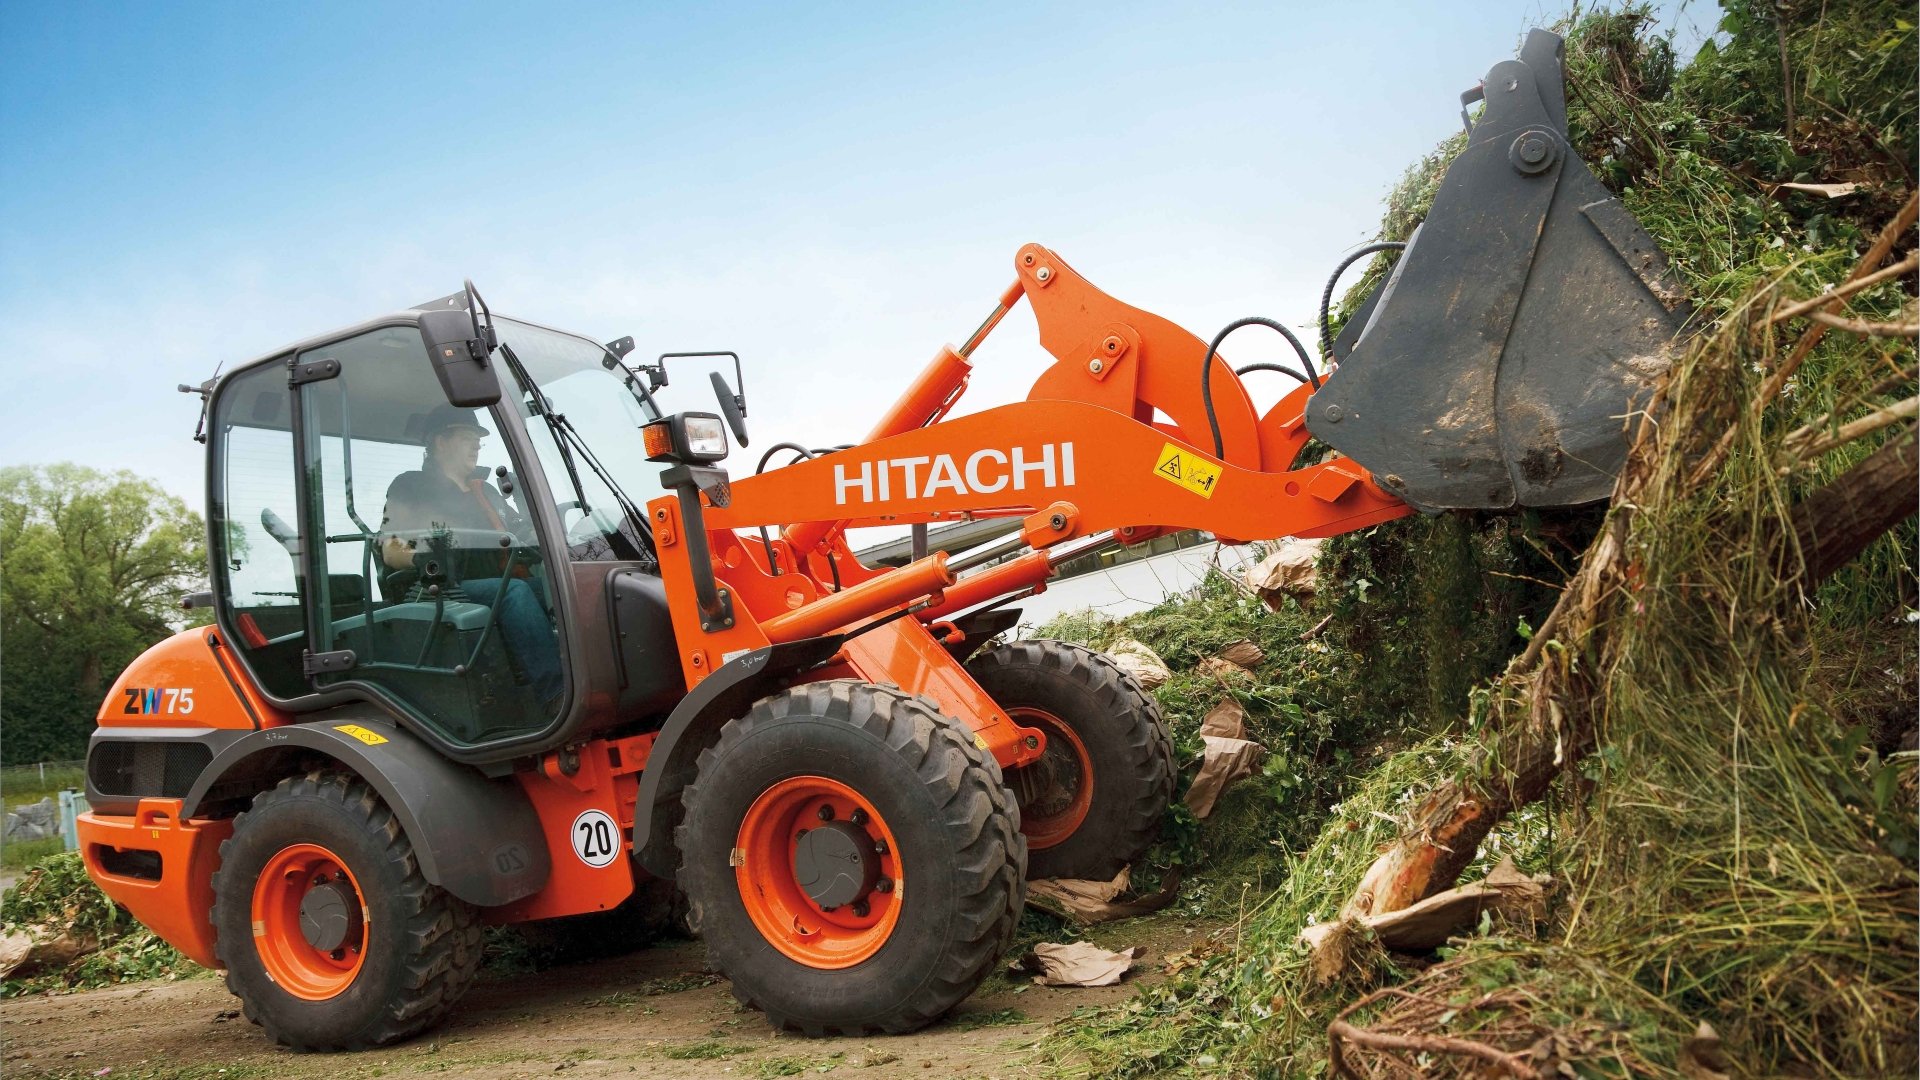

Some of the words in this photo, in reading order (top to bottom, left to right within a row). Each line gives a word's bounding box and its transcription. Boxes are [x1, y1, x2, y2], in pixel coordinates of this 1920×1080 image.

[834, 441, 1076, 505] HITACHI
[753, 654, 767, 663] bar
[579, 820, 612, 858] 20
